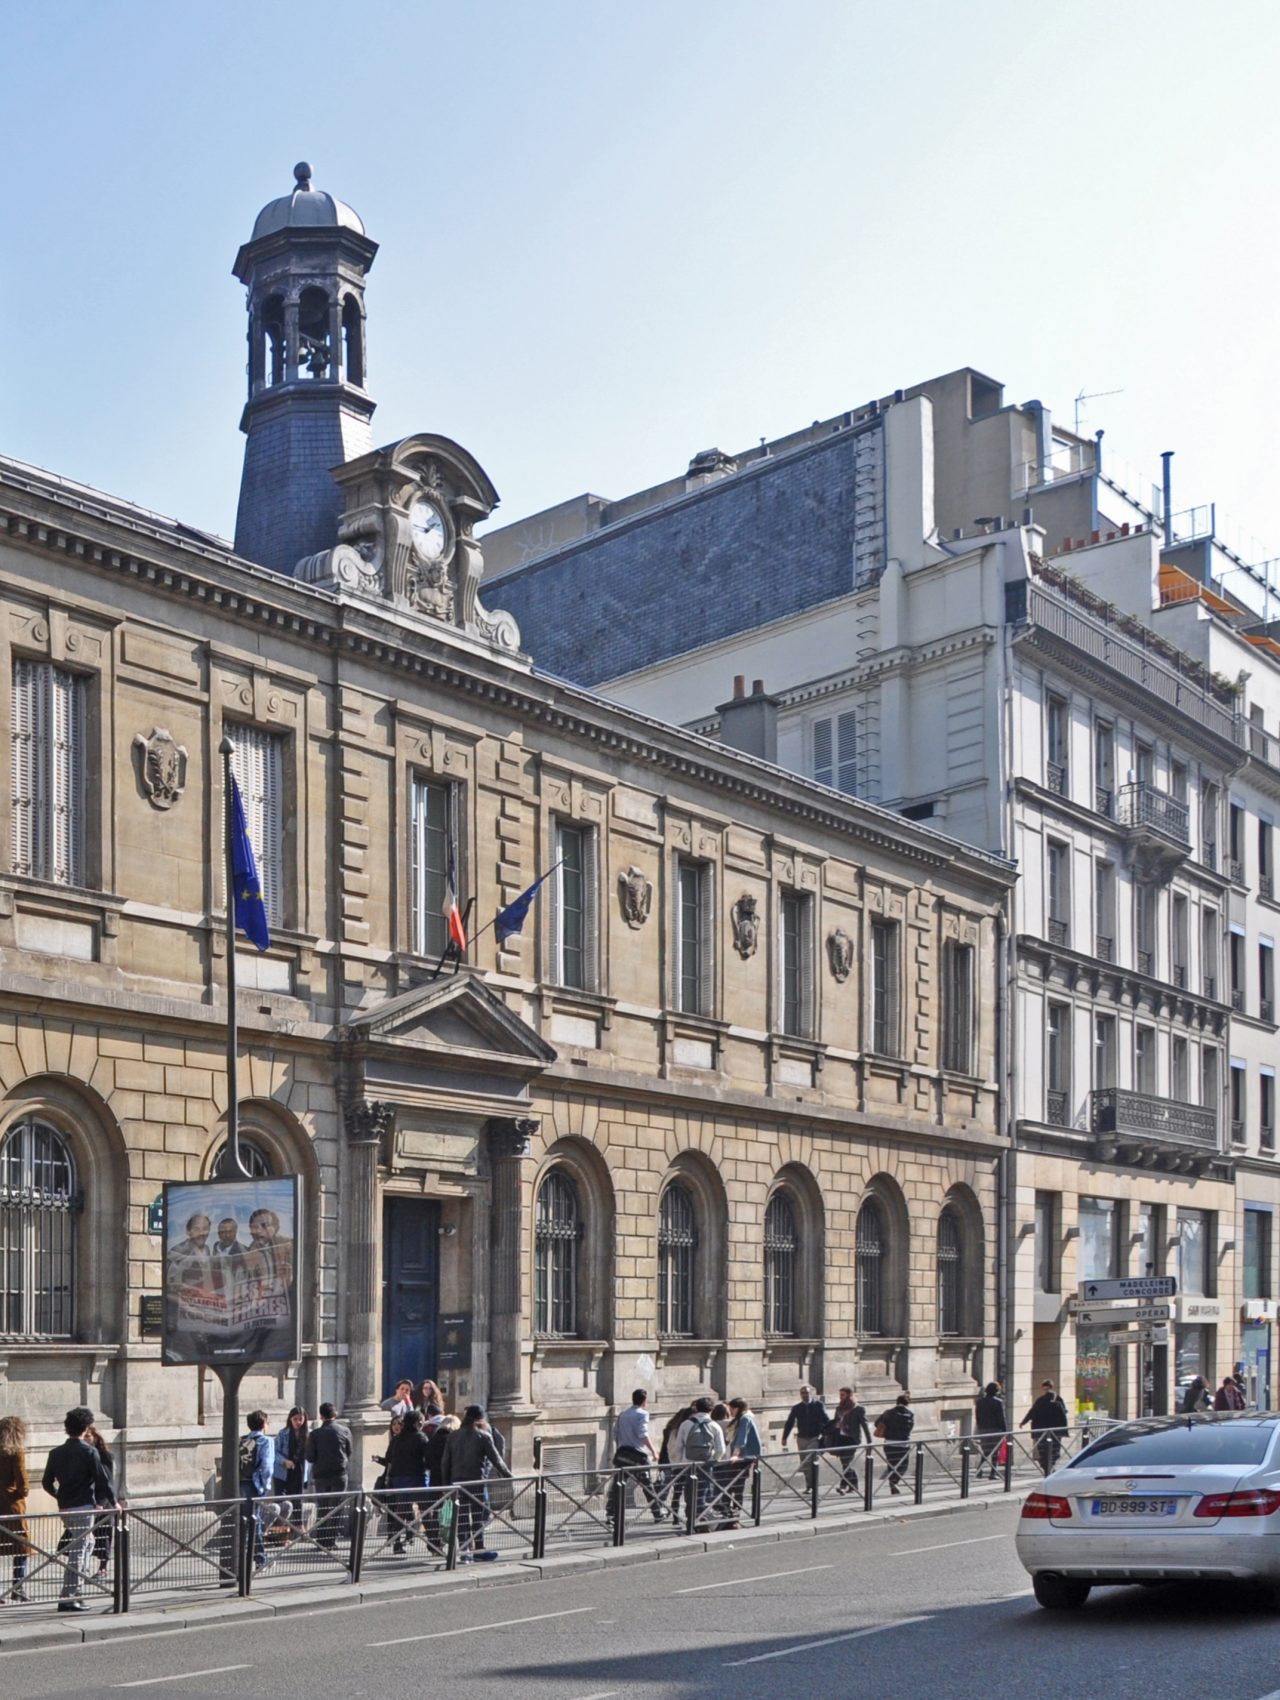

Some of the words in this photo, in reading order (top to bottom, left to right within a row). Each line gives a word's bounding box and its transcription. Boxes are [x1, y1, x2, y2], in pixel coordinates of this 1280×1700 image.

[1119, 1280, 1170, 1288] MADELEINE
[1123, 1287, 1170, 1296] CONCORDE
[1135, 1309, 1165, 1317] OPÉRA
[1100, 1501, 1167, 1513] BD-999-ST
